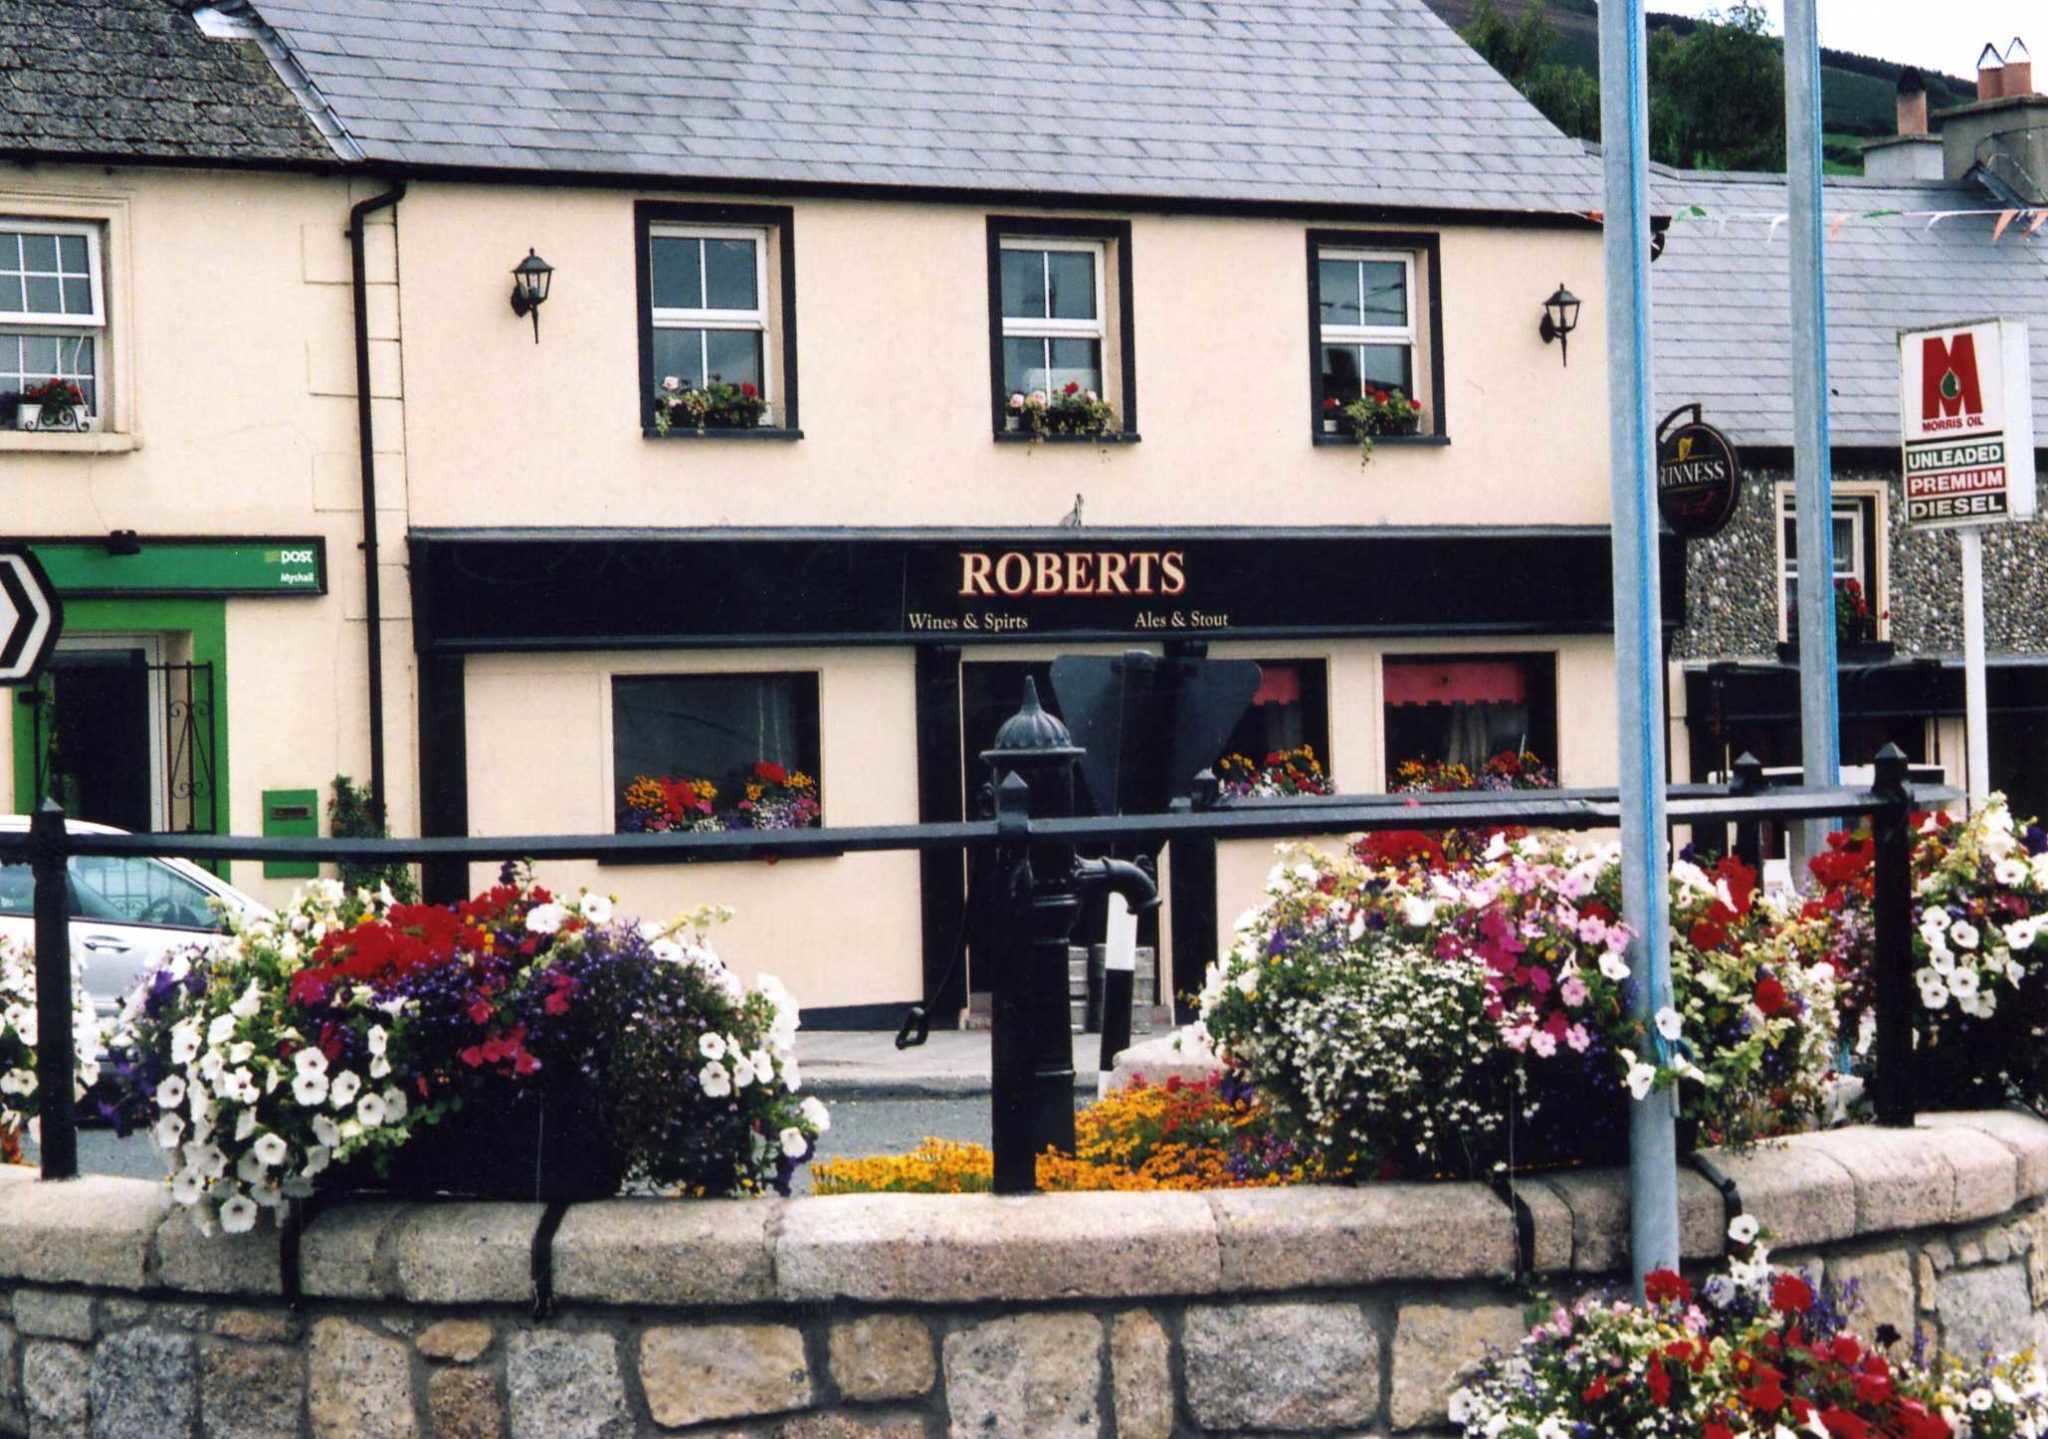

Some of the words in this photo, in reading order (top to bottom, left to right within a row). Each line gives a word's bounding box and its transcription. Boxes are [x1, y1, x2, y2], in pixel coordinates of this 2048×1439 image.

[1922, 418, 1963, 432] MORRIS
[1967, 415, 1984, 427] OIL
[1909, 446, 2001, 469] UNLEADED
[1660, 460, 1725, 487] UINNESS
[1911, 470, 2003, 494] PREMIUM
[1911, 496, 2003, 519] DIESEL
[281, 572, 315, 585] Myshall
[959, 551, 1186, 597] ROBERTS
[908, 613, 958, 630] Wines
[963, 612, 979, 630] &
[984, 612, 1028, 632] Spirts
[1135, 611, 1166, 628] Ales
[1171, 610, 1186, 628] &
[1191, 610, 1228, 628] Stout
